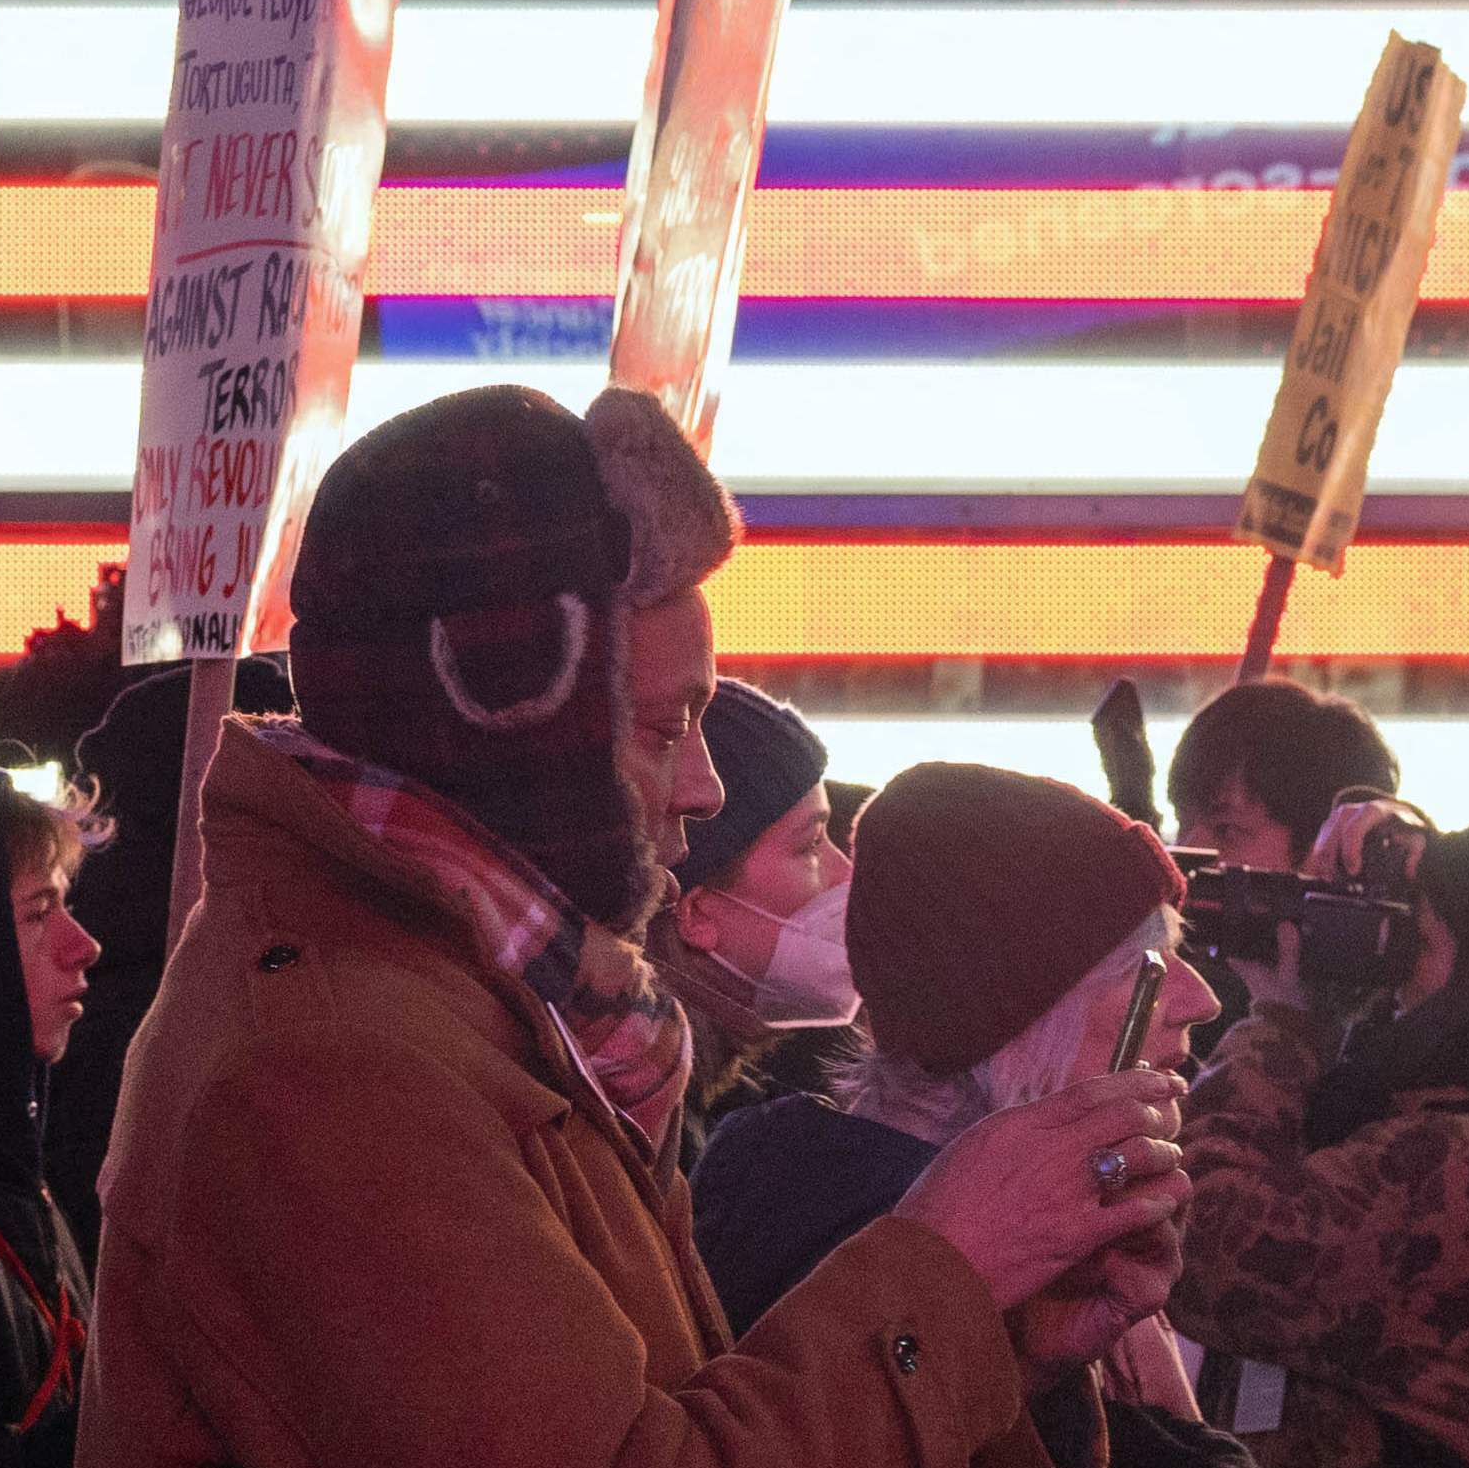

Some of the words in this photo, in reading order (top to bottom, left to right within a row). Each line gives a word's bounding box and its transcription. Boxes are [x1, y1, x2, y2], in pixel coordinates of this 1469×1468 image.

[203, 128, 298, 225] NEVER
[145, 259, 253, 360] AGAINST
[198, 349, 300, 437] TERROR
